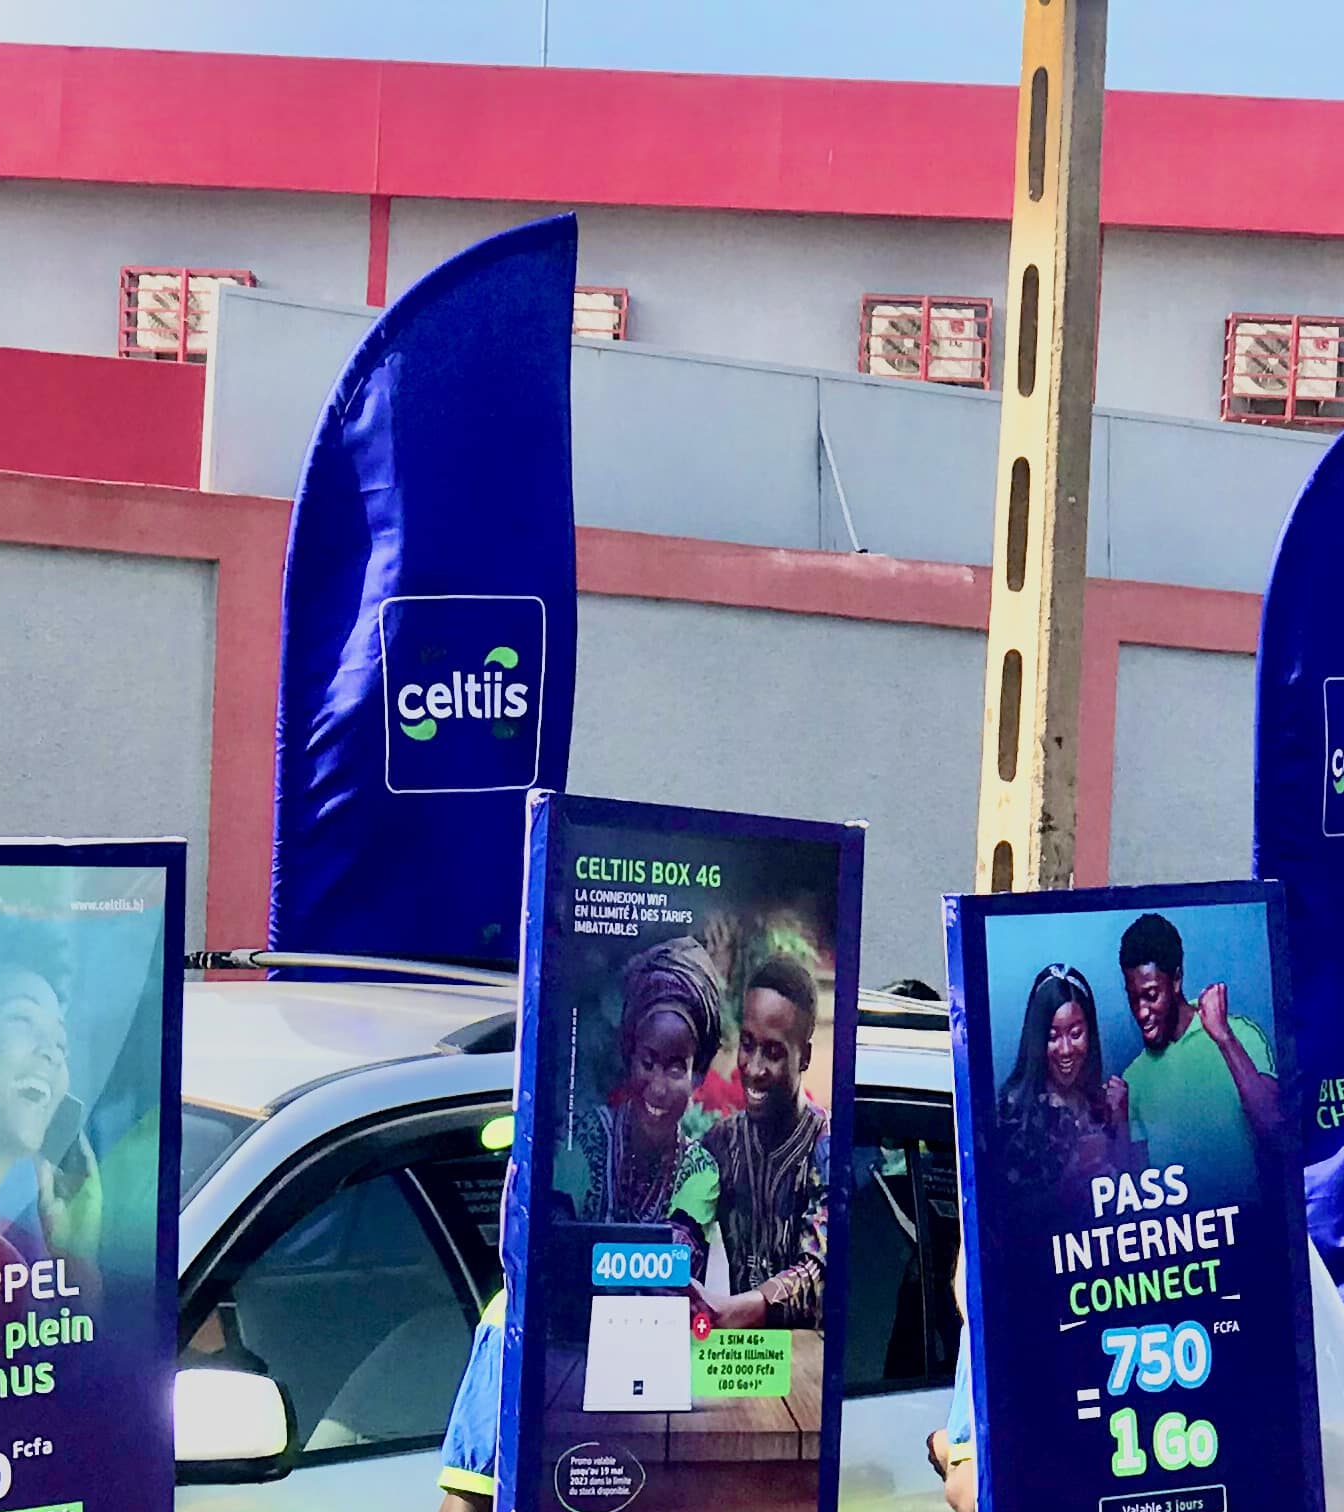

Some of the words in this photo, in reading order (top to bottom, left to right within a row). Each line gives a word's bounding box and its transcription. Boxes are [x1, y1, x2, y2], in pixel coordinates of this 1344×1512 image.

[397, 671, 529, 720] celtiis
[575, 856, 646, 884] CELTIIS
[651, 861, 690, 887] BOX
[695, 865, 721, 888] 4G
[575, 889, 588, 902] LA
[590, 890, 646, 905] CONNEXION
[647, 893, 667, 906] WIFI
[574, 905, 588, 917] EN
[590, 904, 630, 920] ILLIMITÉ
[640, 908, 659, 921] DES
[661, 909, 693, 924] TARIFS
[574, 920, 638, 936] IMBATTABLES
[1091, 1165, 1188, 1218] PASS
[1052, 1206, 1240, 1274] INTERNET
[596, 1252, 626, 1279] 40
[629, 1252, 673, 1279] 000
[1069, 1259, 1221, 1316] CONNECT
[5, 1308, 94, 1359] plein
[719, 1334, 726, 1345] 1
[727, 1334, 745, 1346] SIM
[699, 1349, 705, 1361] 2
[707, 1348, 742, 1361] forfaits
[1103, 1322, 1210, 1394] 750
[1213, 1320, 1240, 1334] FCFA
[707, 1363, 718, 1375] de
[720, 1364, 733, 1375] 20
[735, 1364, 753, 1375] 000
[755, 1364, 775, 1376] Fcfa
[13, 1437, 53, 1460] Fcfa
[1110, 1408, 1147, 1476] 1
[1153, 1412, 1218, 1470] Go
[1165, 1500, 1172, 1512] 3
